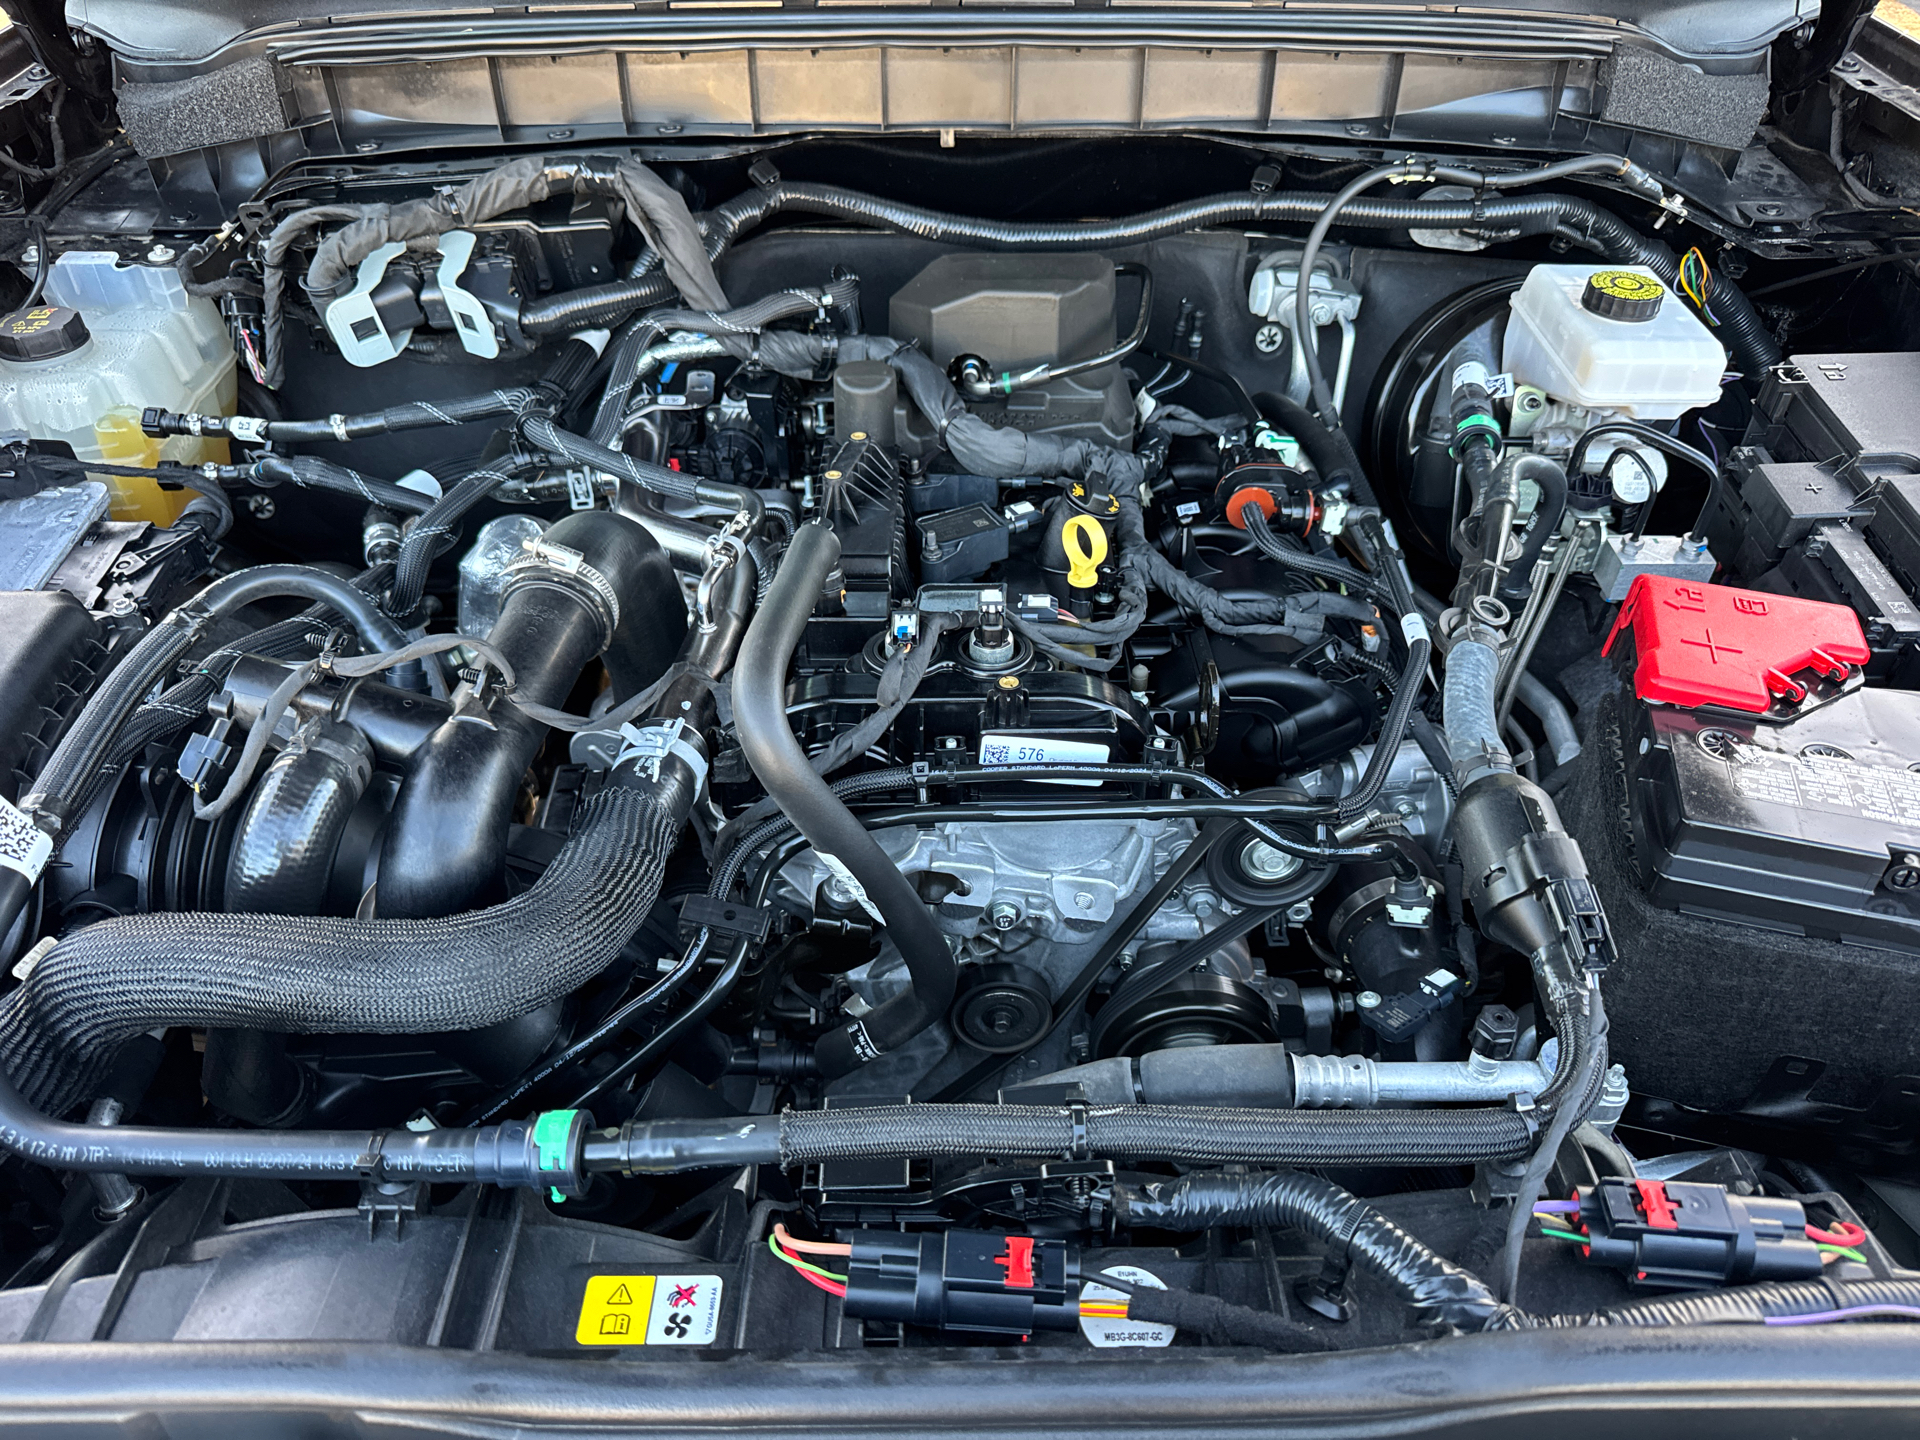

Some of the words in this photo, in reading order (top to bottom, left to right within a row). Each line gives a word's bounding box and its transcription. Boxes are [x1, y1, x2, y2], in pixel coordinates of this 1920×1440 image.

[1018, 746, 1045, 762] 576
[645, 982, 671, 1003] COOPER
[29, 1140, 58, 1159] 17.6
